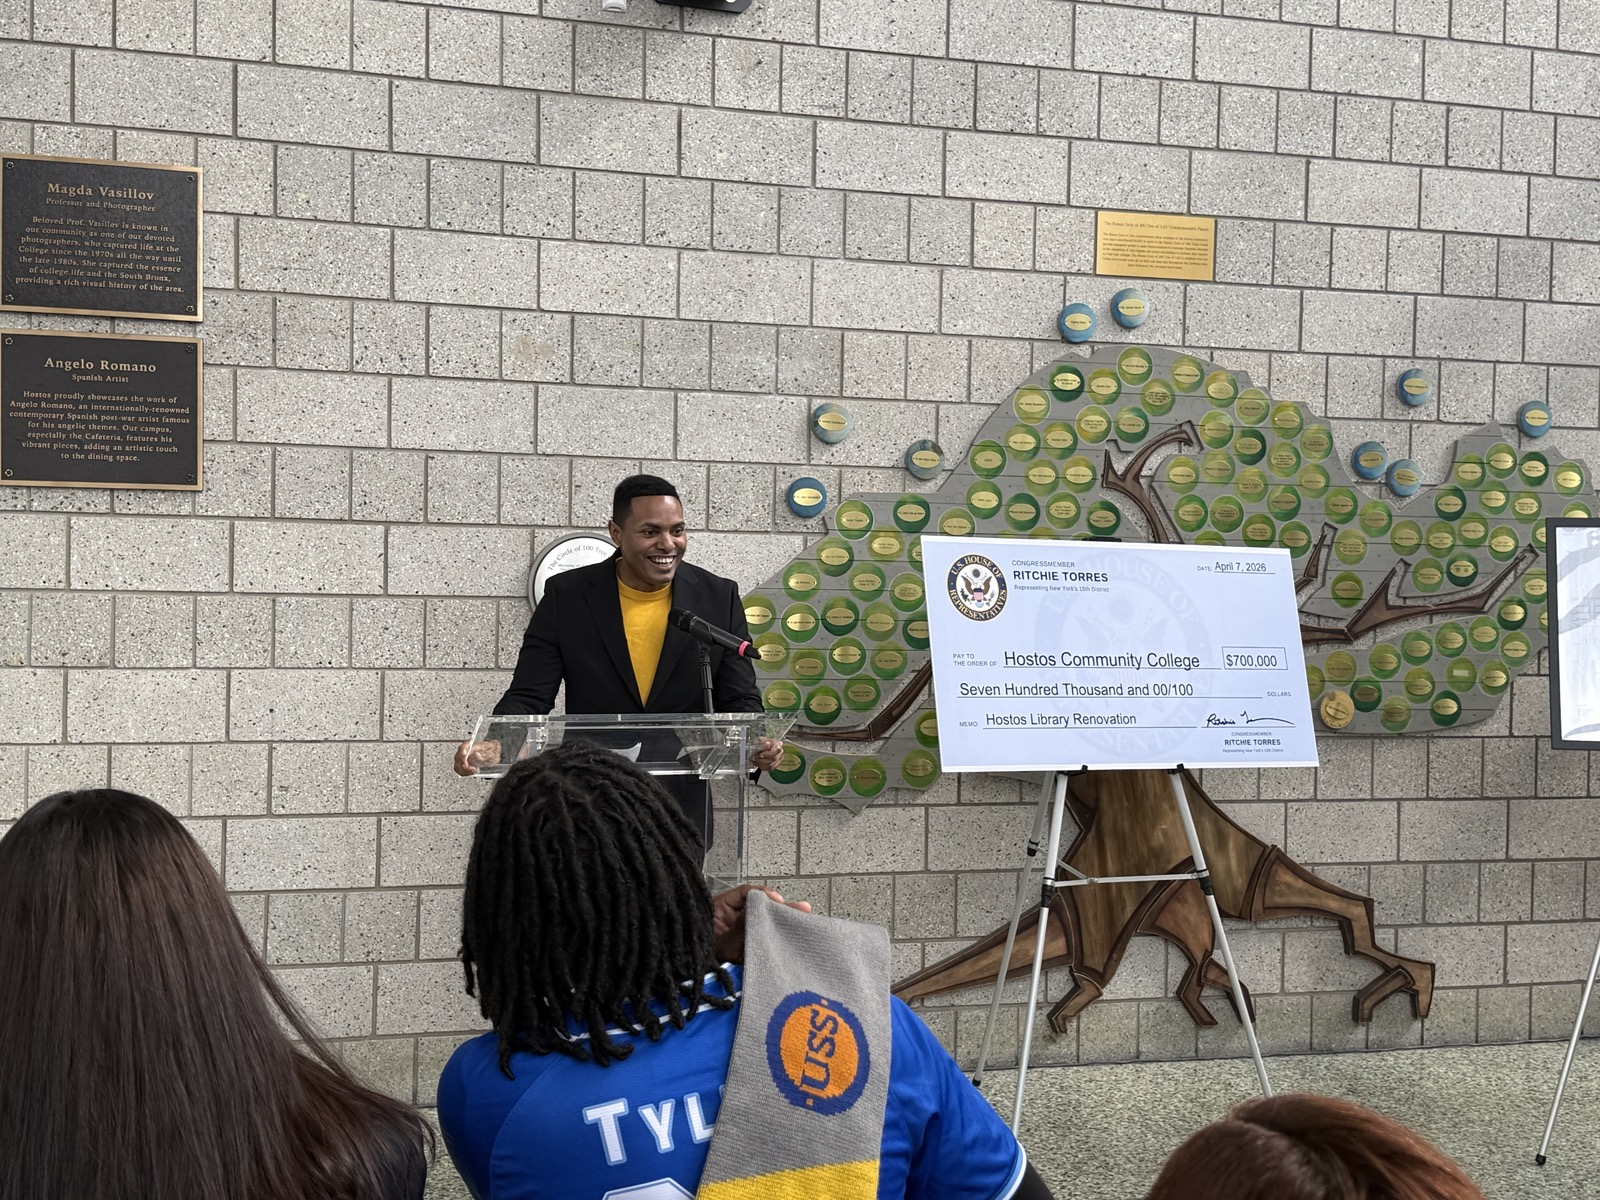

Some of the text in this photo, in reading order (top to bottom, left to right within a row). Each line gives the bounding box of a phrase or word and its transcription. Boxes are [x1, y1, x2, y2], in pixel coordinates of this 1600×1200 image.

[48, 183, 154, 200] Magda Vasillov
[47, 197, 82, 206] Professor
[104, 202, 155, 212] Photographer
[33, 216, 64, 224] Beloved
[88, 220, 120, 228] Vasillov
[122, 221, 129, 229] is
[132, 223, 158, 231] known
[160, 224, 169, 232] in
[42, 228, 87, 237] community
[144, 233, 175, 242] devoted
[21, 236, 81, 246] photographers,
[103, 242, 137, 250] captured
[140, 243, 154, 251] life
[19, 245, 48, 255] College
[92, 250, 114, 258] 1970s
[145, 255, 160, 263] way
[163, 255, 181, 263] until
[54, 258, 79, 266] 1980s.
[82, 259, 96, 267] She
[151, 265, 181, 273] essence
[40, 267, 69, 276] college
[119, 272, 143, 280] South
[145, 274, 171, 282] Bronx,
[16, 277, 54, 286] providing
[109, 281, 137, 291] history
[44, 358, 156, 372] Angelo Romano
[72, 374, 129, 383] Spanish Artist
[54, 393, 85, 401] proudly
[87, 393, 128, 401] showcases
[10, 400, 38, 409] Angelo
[41, 401, 75, 410] Romano,
[91, 404, 190, 414] internationally-renowned
[9, 412, 65, 420] contemporary
[67, 412, 98, 421] Spanish
[58, 422, 85, 430] angelic
[140, 426, 172, 434] campus,
[28, 432, 65, 440] especially
[85, 433, 123, 441] Cafeteria,
[126, 434, 158, 442] features
[53, 442, 80, 450] pieces,
[84, 443, 110, 452] adding
[88, 453, 114, 462] dining
[548, 560, 558, 570] The
[556, 549, 573, 560] Circle
[595, 547, 607, 556] Tree
[1011, 560, 1075, 568] CONGRESSMEMBER
[951, 555, 1003, 579] U.S. HOUSE OF
[1215, 562, 1234, 573] April
[1235, 562, 1244, 572] 7,
[1245, 563, 1267, 572] 2026
[1013, 570, 1108, 582] RITCHIE TORRES
[949, 589, 1007, 620] REPRESENTATIVES
[1004, 651, 1200, 670] Hostos Community College
[1226, 654, 1278, 668] $700,000
[960, 682, 1194, 696] Seven Hundred Thousand and 00/100
[986, 713, 1137, 728] Hostos Library Renovation
[801, 1008, 839, 1091] USS
[582, 1085, 727, 1166] TYL
